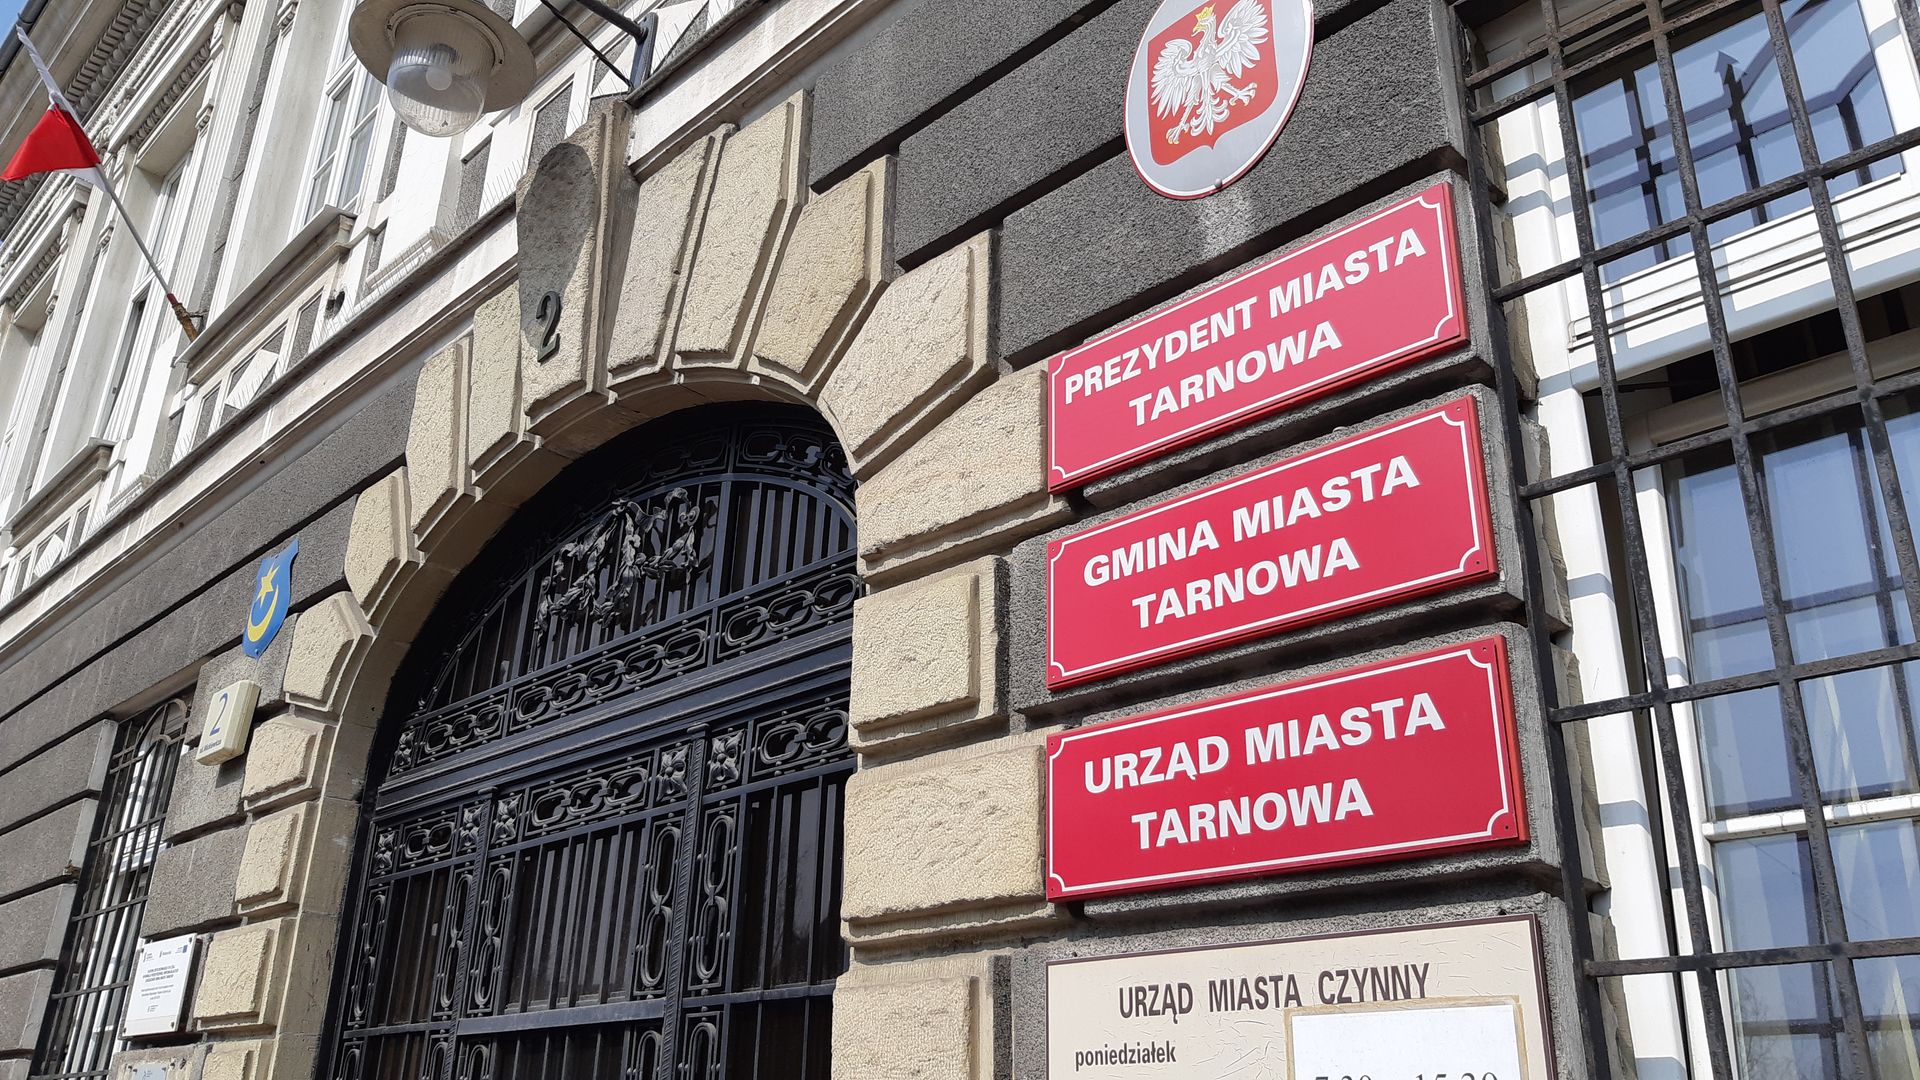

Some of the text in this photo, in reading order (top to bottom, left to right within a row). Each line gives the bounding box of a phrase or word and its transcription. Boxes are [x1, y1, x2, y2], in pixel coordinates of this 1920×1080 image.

[536, 290, 560, 363] 2
[1064, 227, 1427, 405] PREZYDENT MIASTA
[1128, 320, 1342, 427] TARNOWA
[1083, 455, 1420, 588] GMINA MIASTA
[1131, 537, 1360, 629] TARNOWA
[209, 692, 228, 737] 2
[1084, 692, 1446, 794] URZĄD MIASTA
[1131, 777, 1374, 850] TARNOWA
[1119, 962, 1430, 1024] URZĄD MIASTA CZYNNY
[1075, 1040, 1177, 1072] poniedziałek
